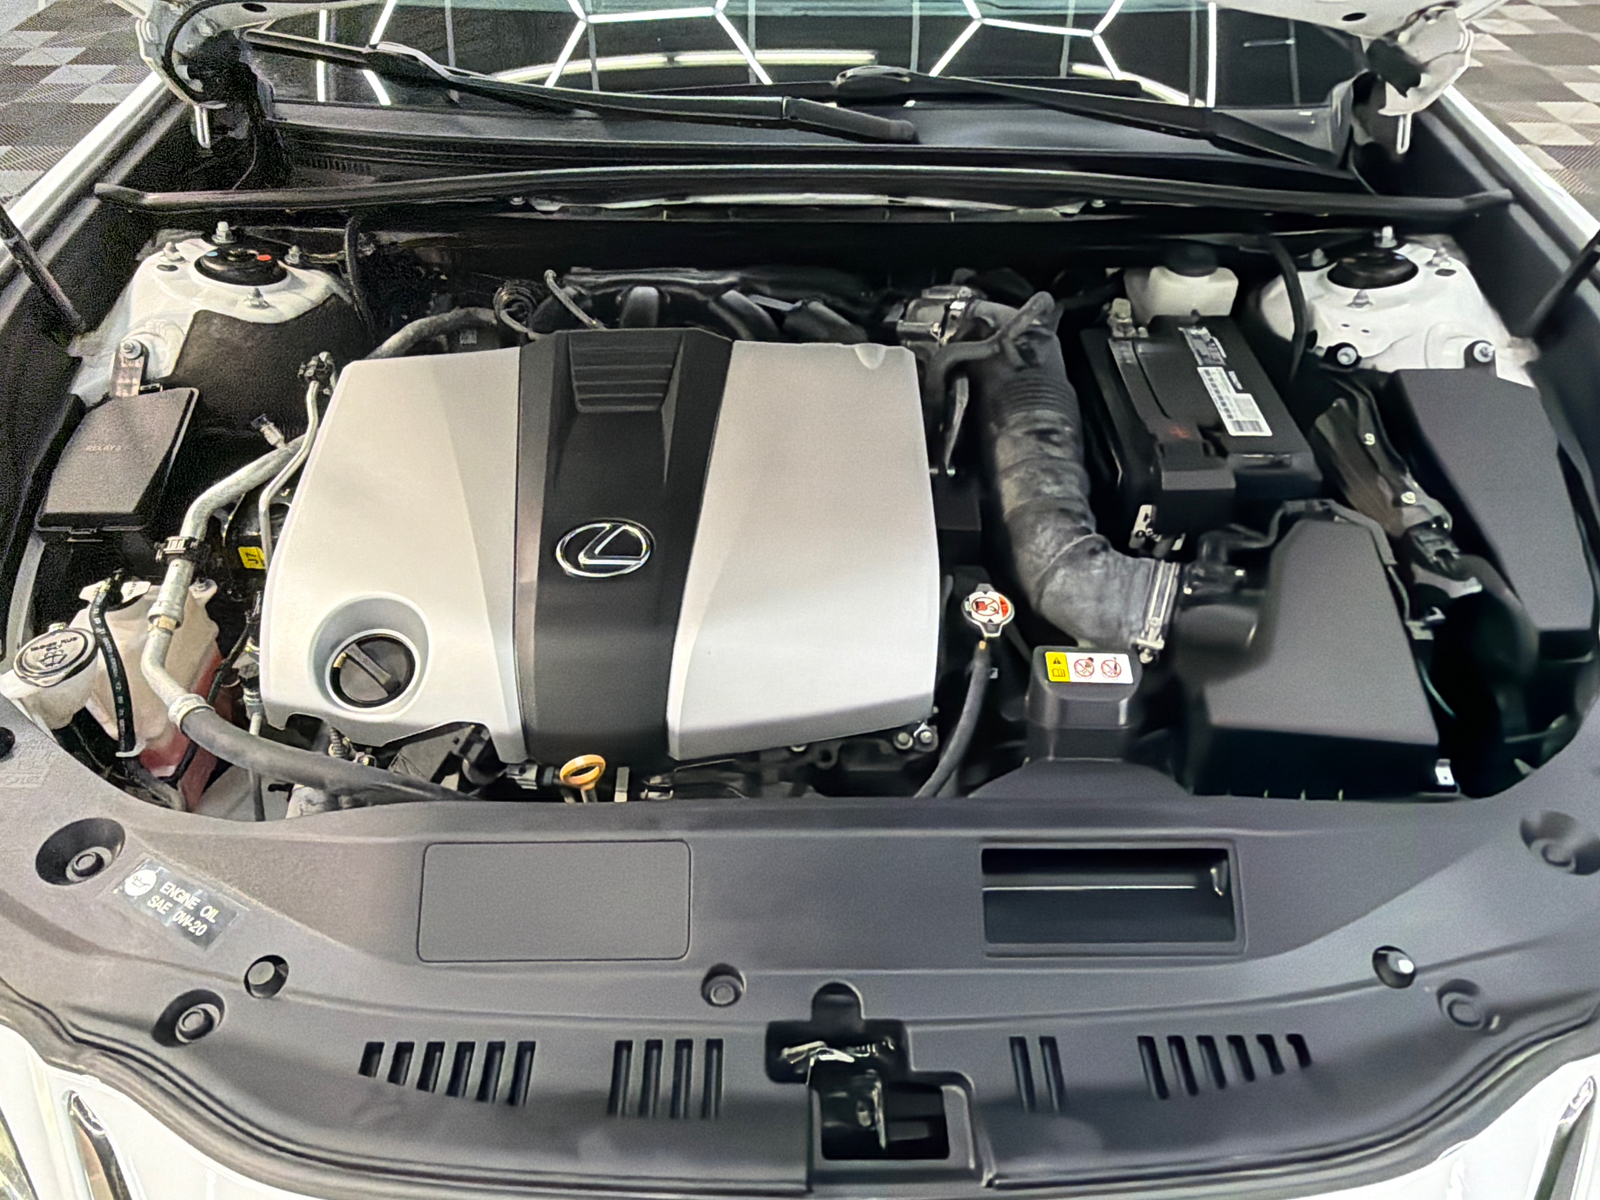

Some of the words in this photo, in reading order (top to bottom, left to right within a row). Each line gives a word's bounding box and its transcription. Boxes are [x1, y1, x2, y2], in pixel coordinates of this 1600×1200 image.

[147, 895, 173, 915] SAE
[159, 881, 202, 911] ENGINE
[200, 905, 220, 924] OIL
